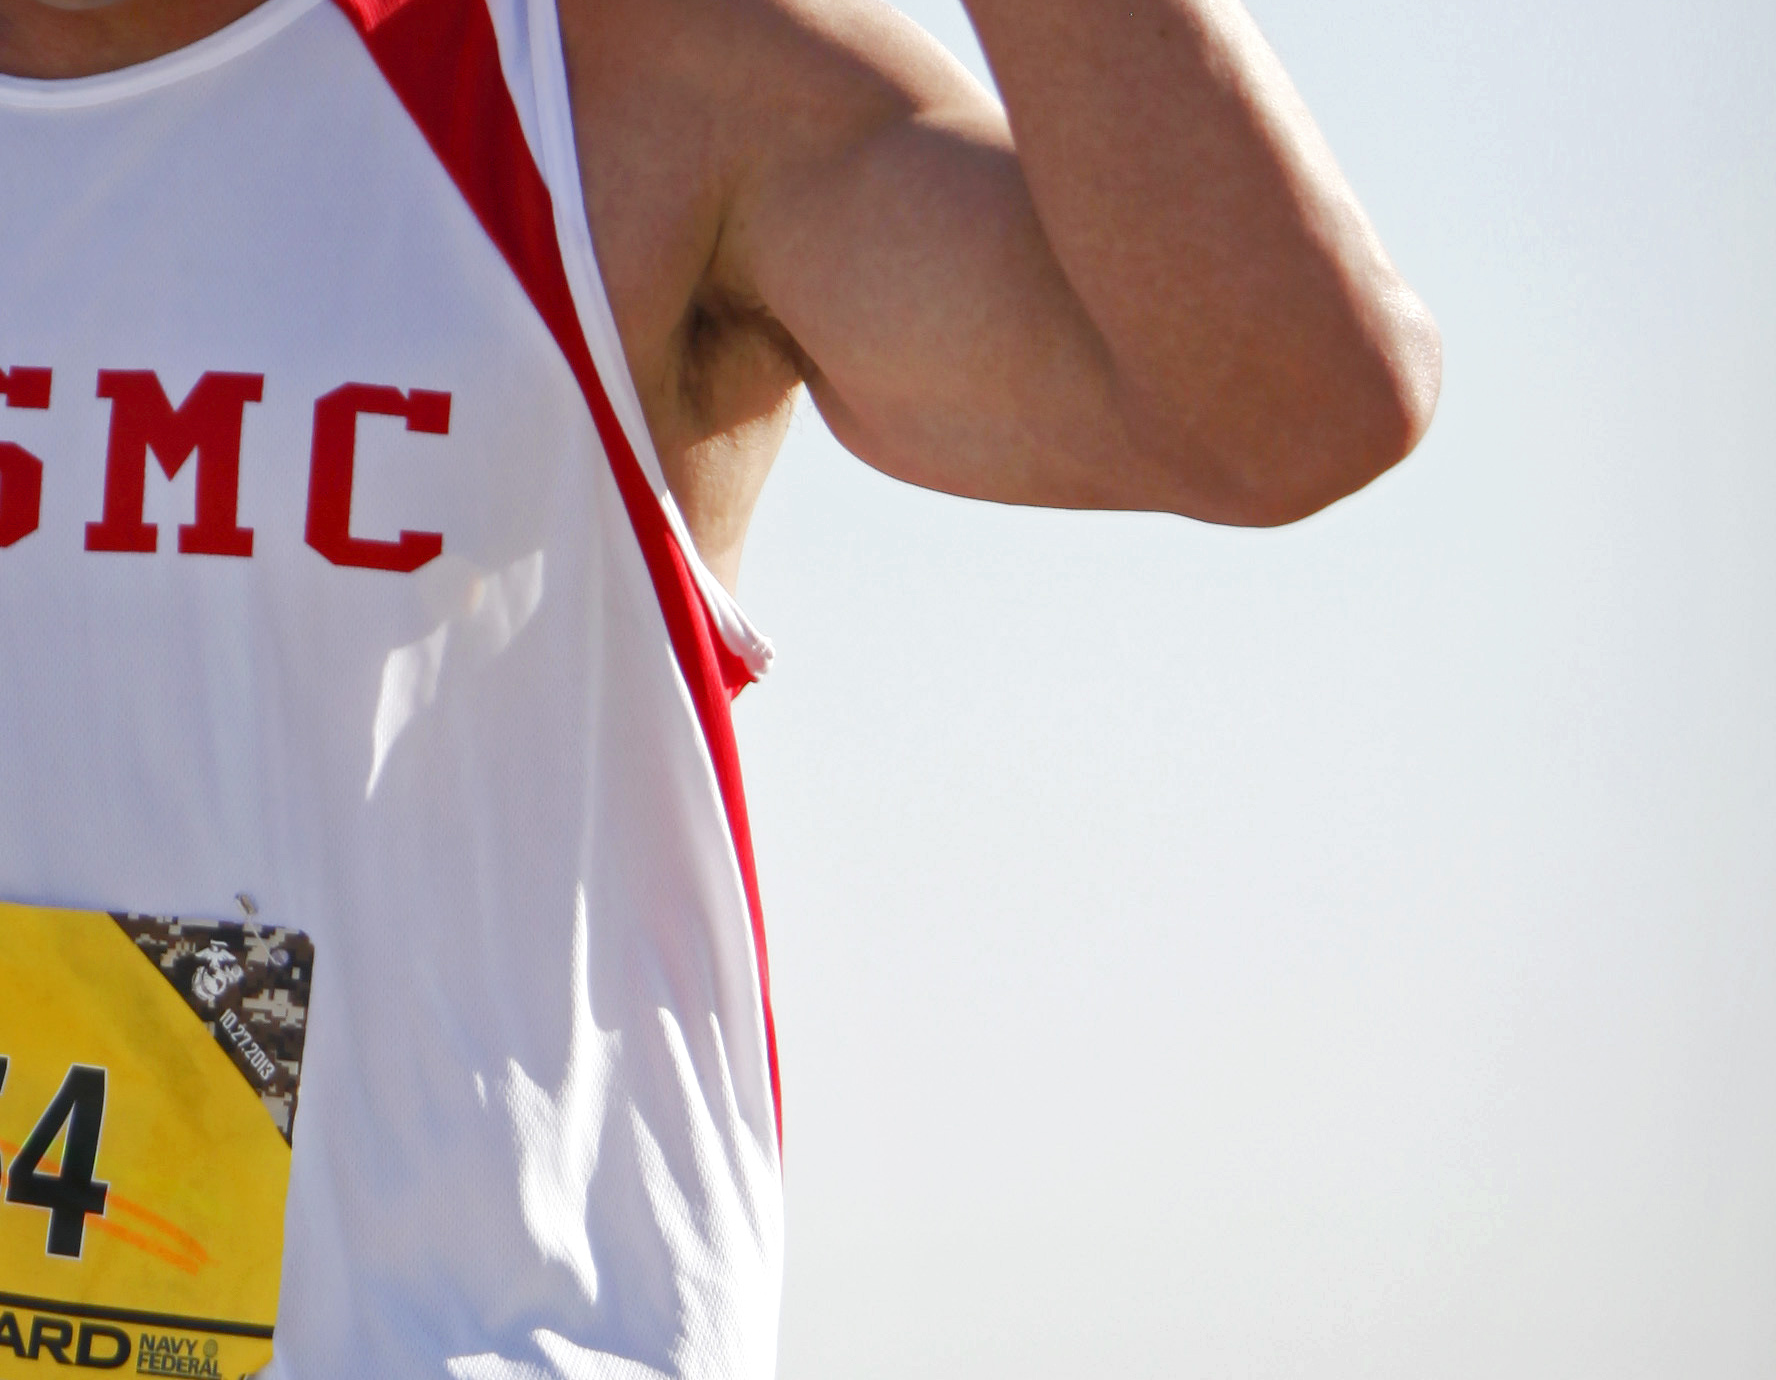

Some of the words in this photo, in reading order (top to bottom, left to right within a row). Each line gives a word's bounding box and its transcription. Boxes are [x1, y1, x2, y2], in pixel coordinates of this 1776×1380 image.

[219, 1007, 276, 1081] 10.27.2013
[139, 1332, 199, 1356] NAVY
[137, 1350, 222, 1378] FEDERAL
